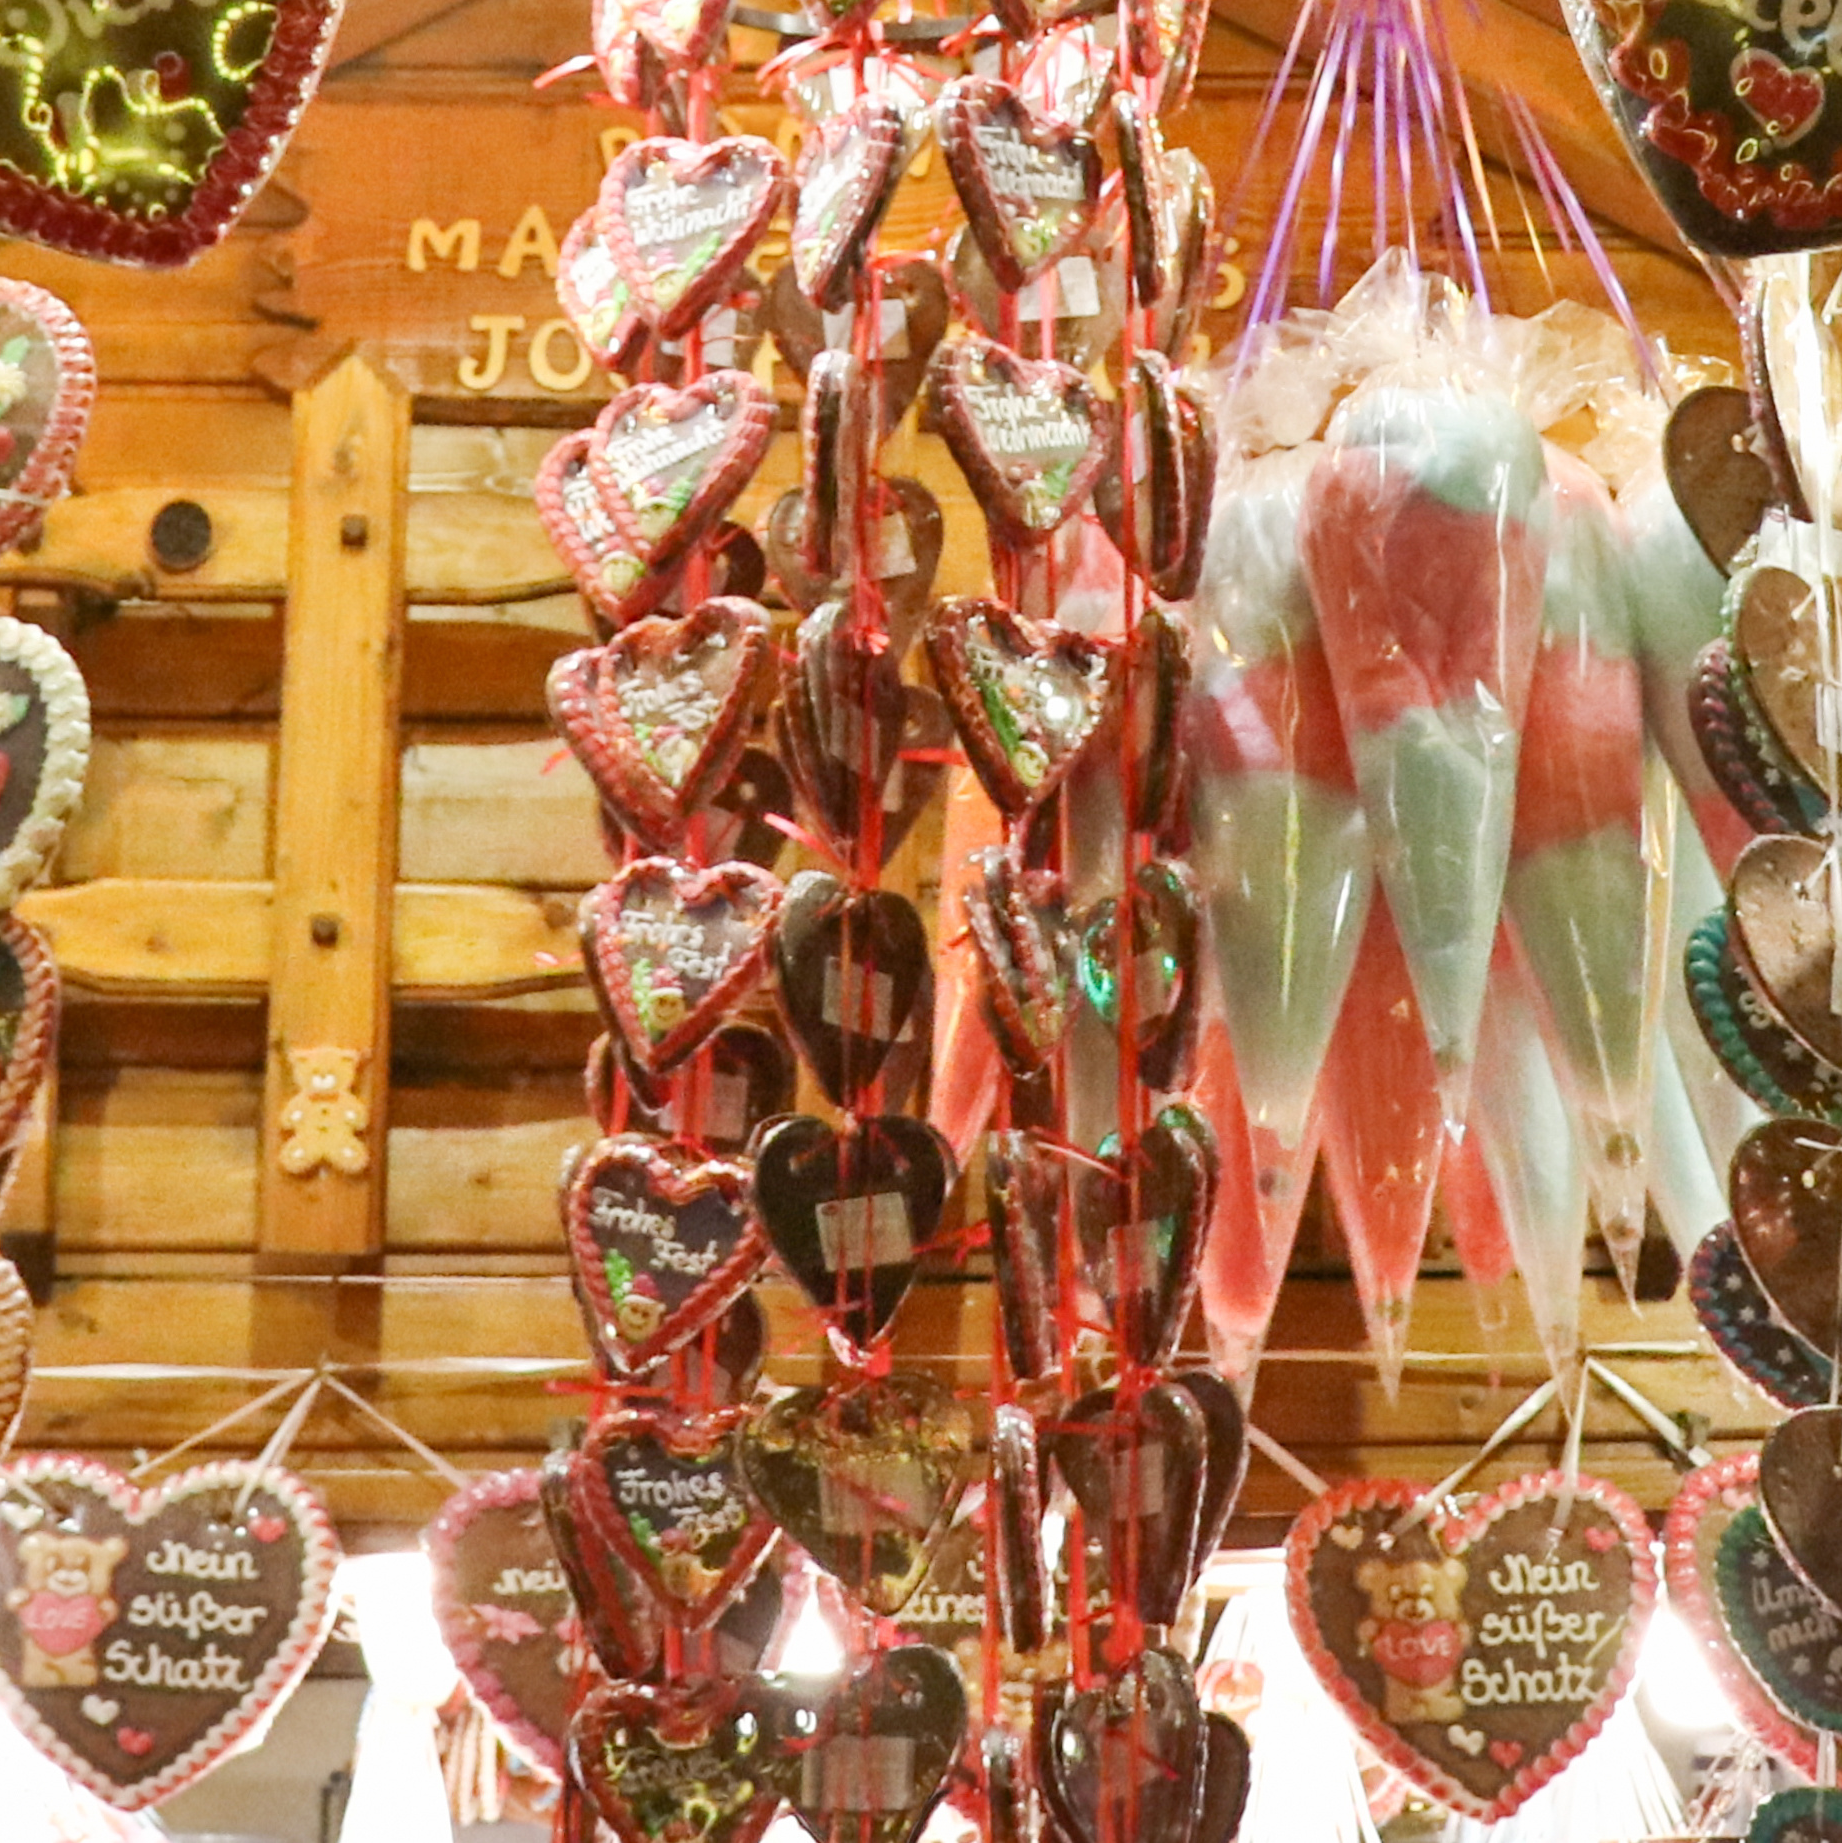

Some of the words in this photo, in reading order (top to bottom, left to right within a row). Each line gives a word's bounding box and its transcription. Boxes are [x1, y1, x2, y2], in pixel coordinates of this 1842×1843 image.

[626, 179, 701, 215] Frohe
[963, 383, 1045, 422] Frohe
[619, 909, 706, 950] Frohes
[588, 1185, 677, 1241] Frohes
[649, 1237, 719, 1276] Fest
[615, 1466, 727, 1508] Frohes
[146, 1539, 260, 1580] Mein
[493, 1559, 570, 1597] Mei
[1489, 1552, 1601, 1596] Mein
[127, 1590, 269, 1640] süßer
[1478, 1599, 1606, 1659] süßer
[102, 1640, 251, 1692] Schatz
[1382, 1632, 1453, 1659] LOVE
[1460, 1652, 1605, 1705] Schatz
